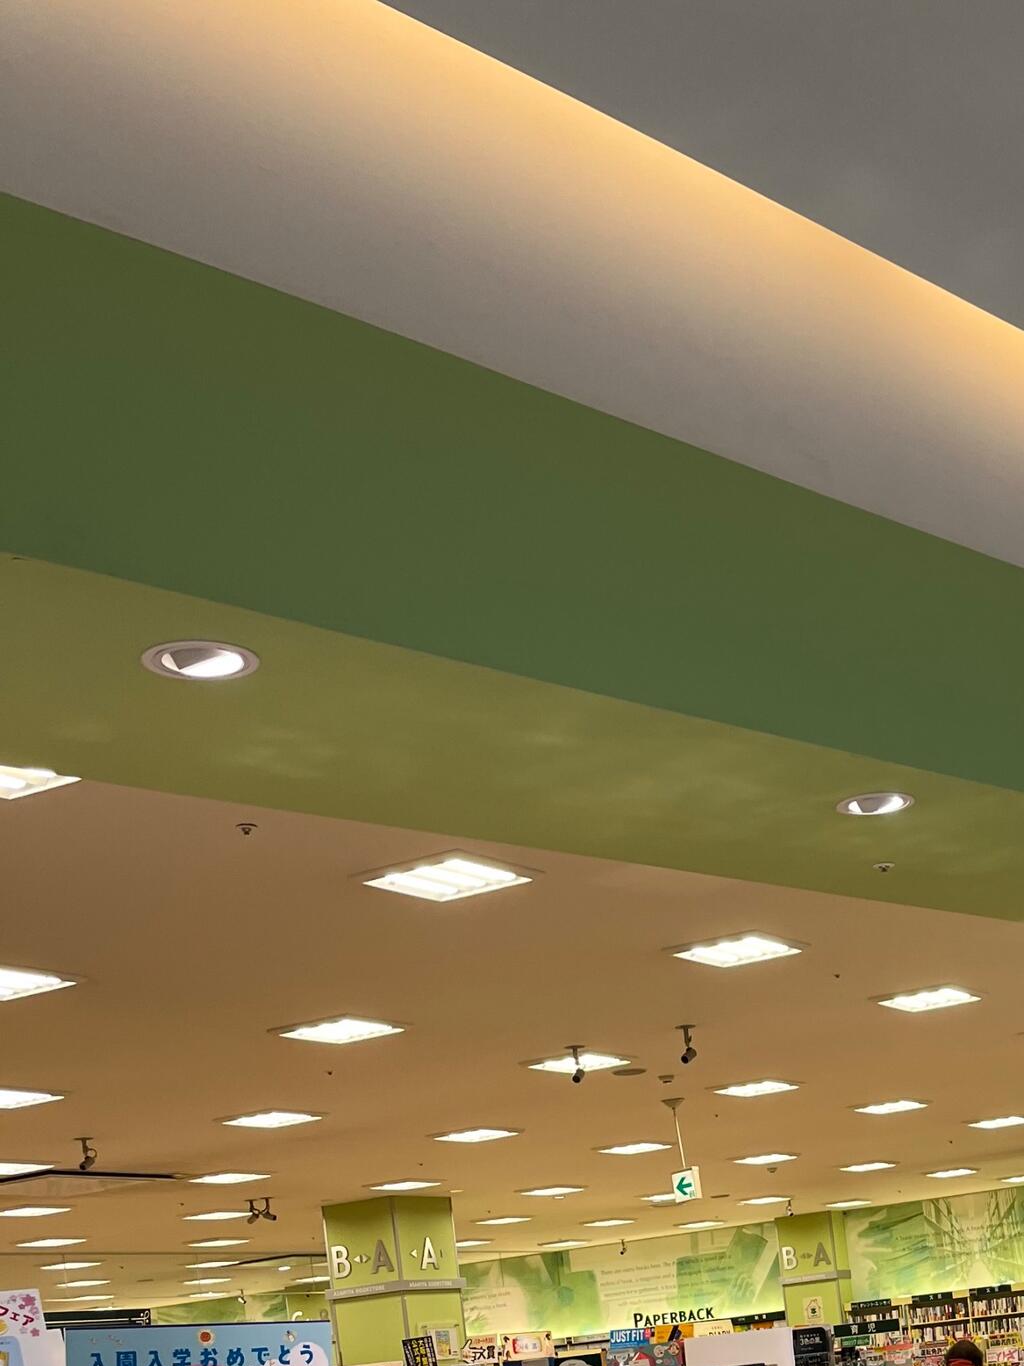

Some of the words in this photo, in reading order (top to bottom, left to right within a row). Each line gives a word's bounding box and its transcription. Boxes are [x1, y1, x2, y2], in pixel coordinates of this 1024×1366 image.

[330, 1245, 351, 1279] B
[371, 1240, 394, 1274] A
[421, 1236, 439, 1270] A
[781, 1246, 798, 1270] B
[813, 1242, 832, 1268] A
[633, 1307, 714, 1327] PAPERBACK
[850, 1323, 876, 1335] 育児
[610, 1331, 631, 1343] JUST
[632, 1329, 644, 1340] FIT
